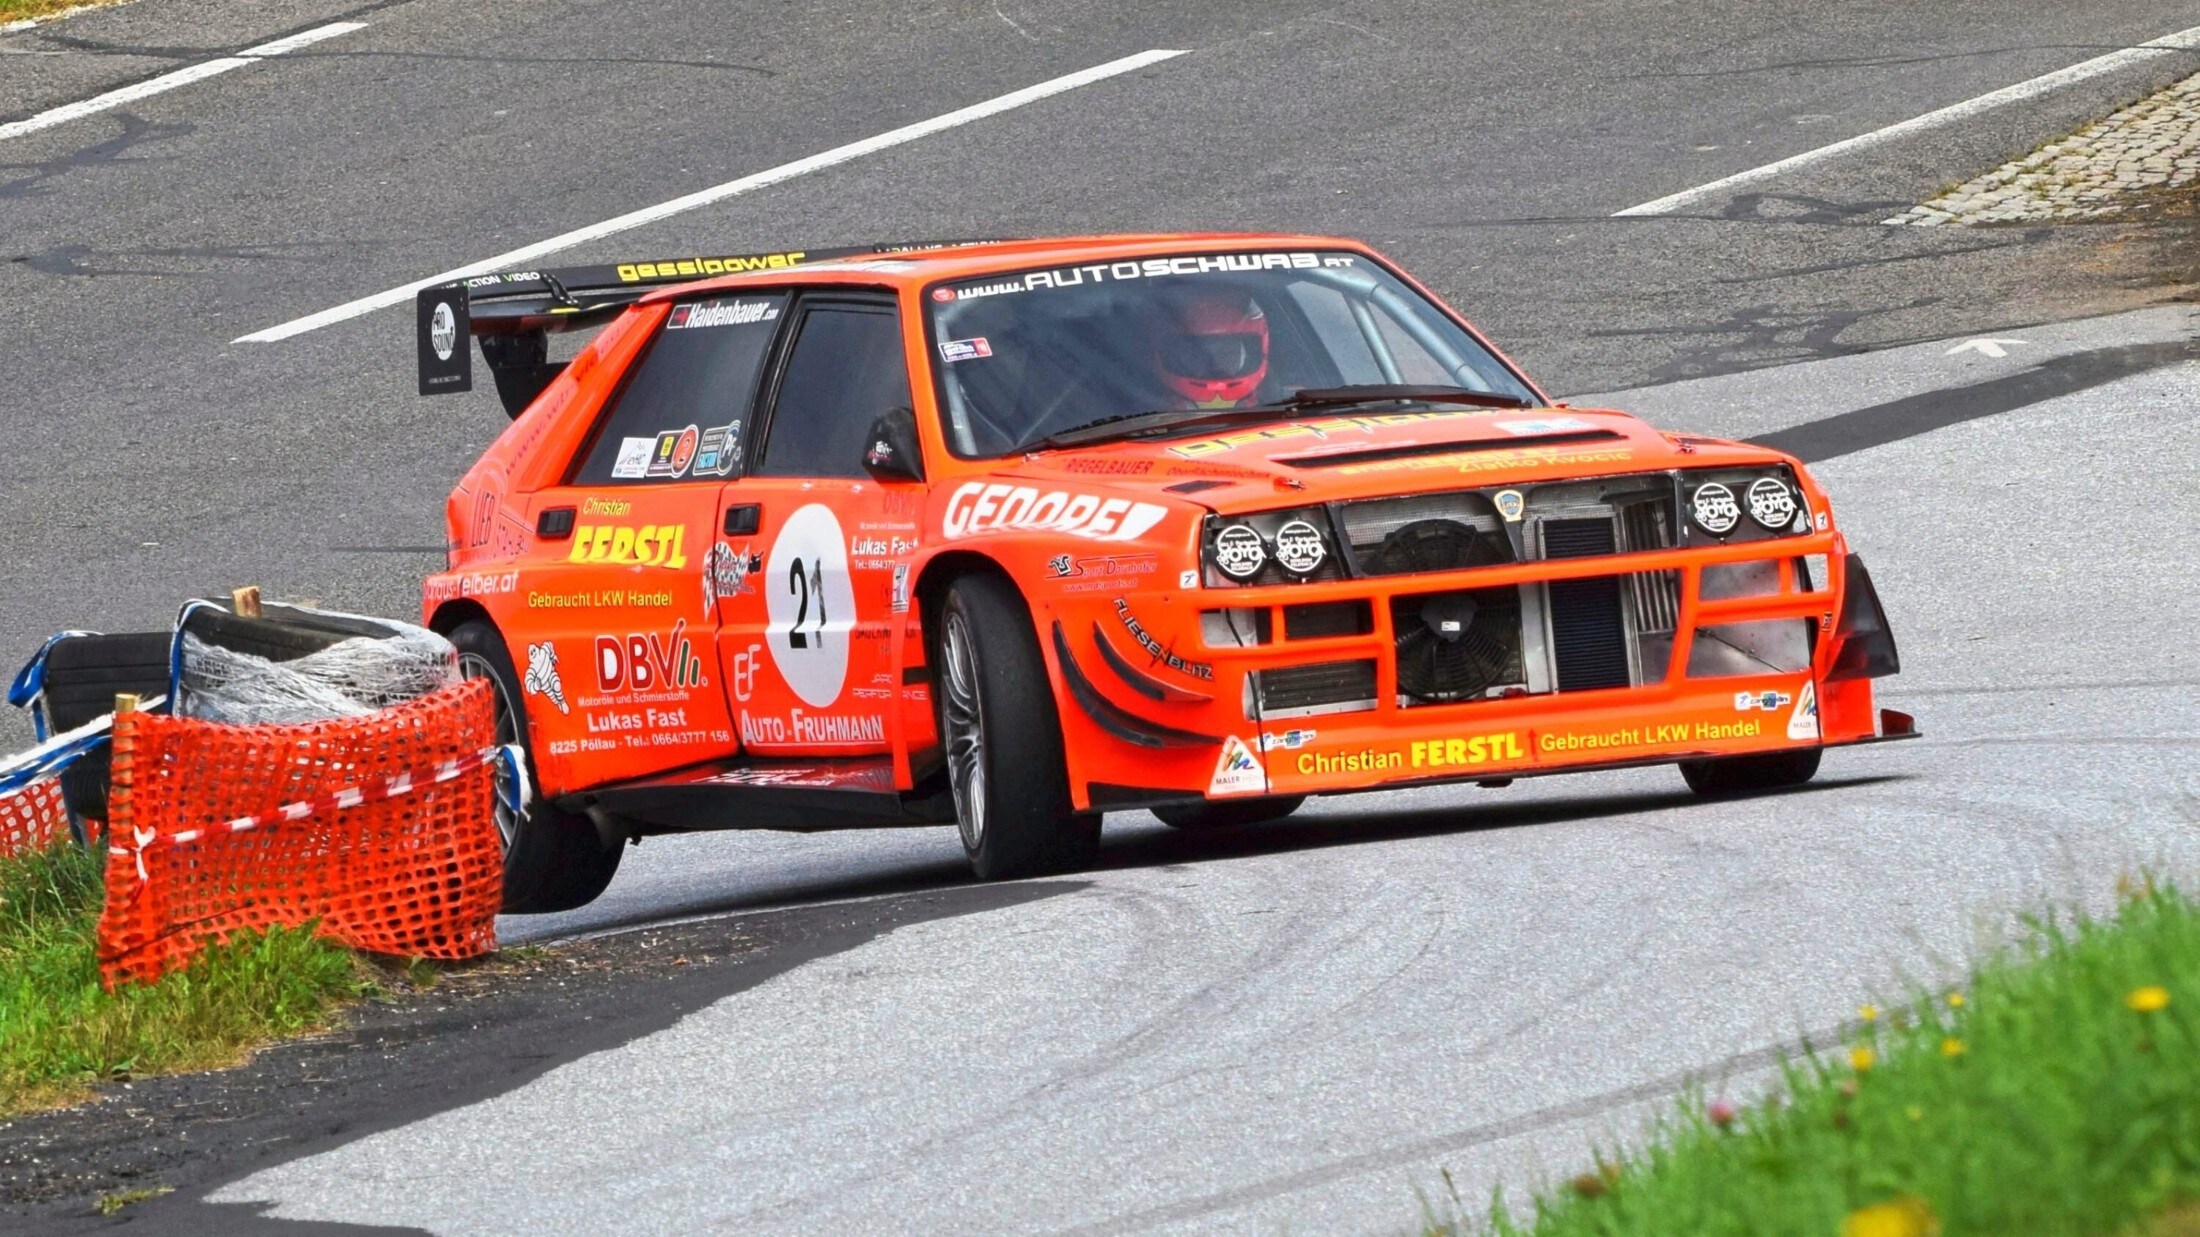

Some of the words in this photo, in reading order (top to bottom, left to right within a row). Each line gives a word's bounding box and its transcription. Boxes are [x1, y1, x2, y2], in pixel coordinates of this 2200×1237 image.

[503, 271, 541, 282] VIDEO
[617, 252, 806, 282] gesslpower
[582, 496, 632, 517] Christian
[851, 536, 888, 556] Lukas
[528, 591, 591, 608] Gebraucht
[594, 591, 625, 607] LKW
[628, 591, 673, 606] Handel
[789, 556, 827, 649] 21
[577, 695, 615, 708] Motoröle
[616, 693, 632, 705] und
[632, 690, 690, 704] Schmierstoffe
[586, 712, 643, 733] Lukas
[647, 707, 688, 729] Fast
[550, 741, 578, 755] 8225
[580, 737, 616, 751] Pöllau
[624, 735, 650, 748] Tel.:
[652, 731, 707, 746] 0664/3777
[710, 730, 730, 743] 156
[1540, 727, 1639, 752] Gebraucht
[1644, 724, 1690, 745] LKW
[1695, 718, 1761, 740] Handel
[1297, 748, 1403, 775] Christian
[1410, 732, 1524, 768] FERSTL
[1215, 775, 1240, 785] MALER
